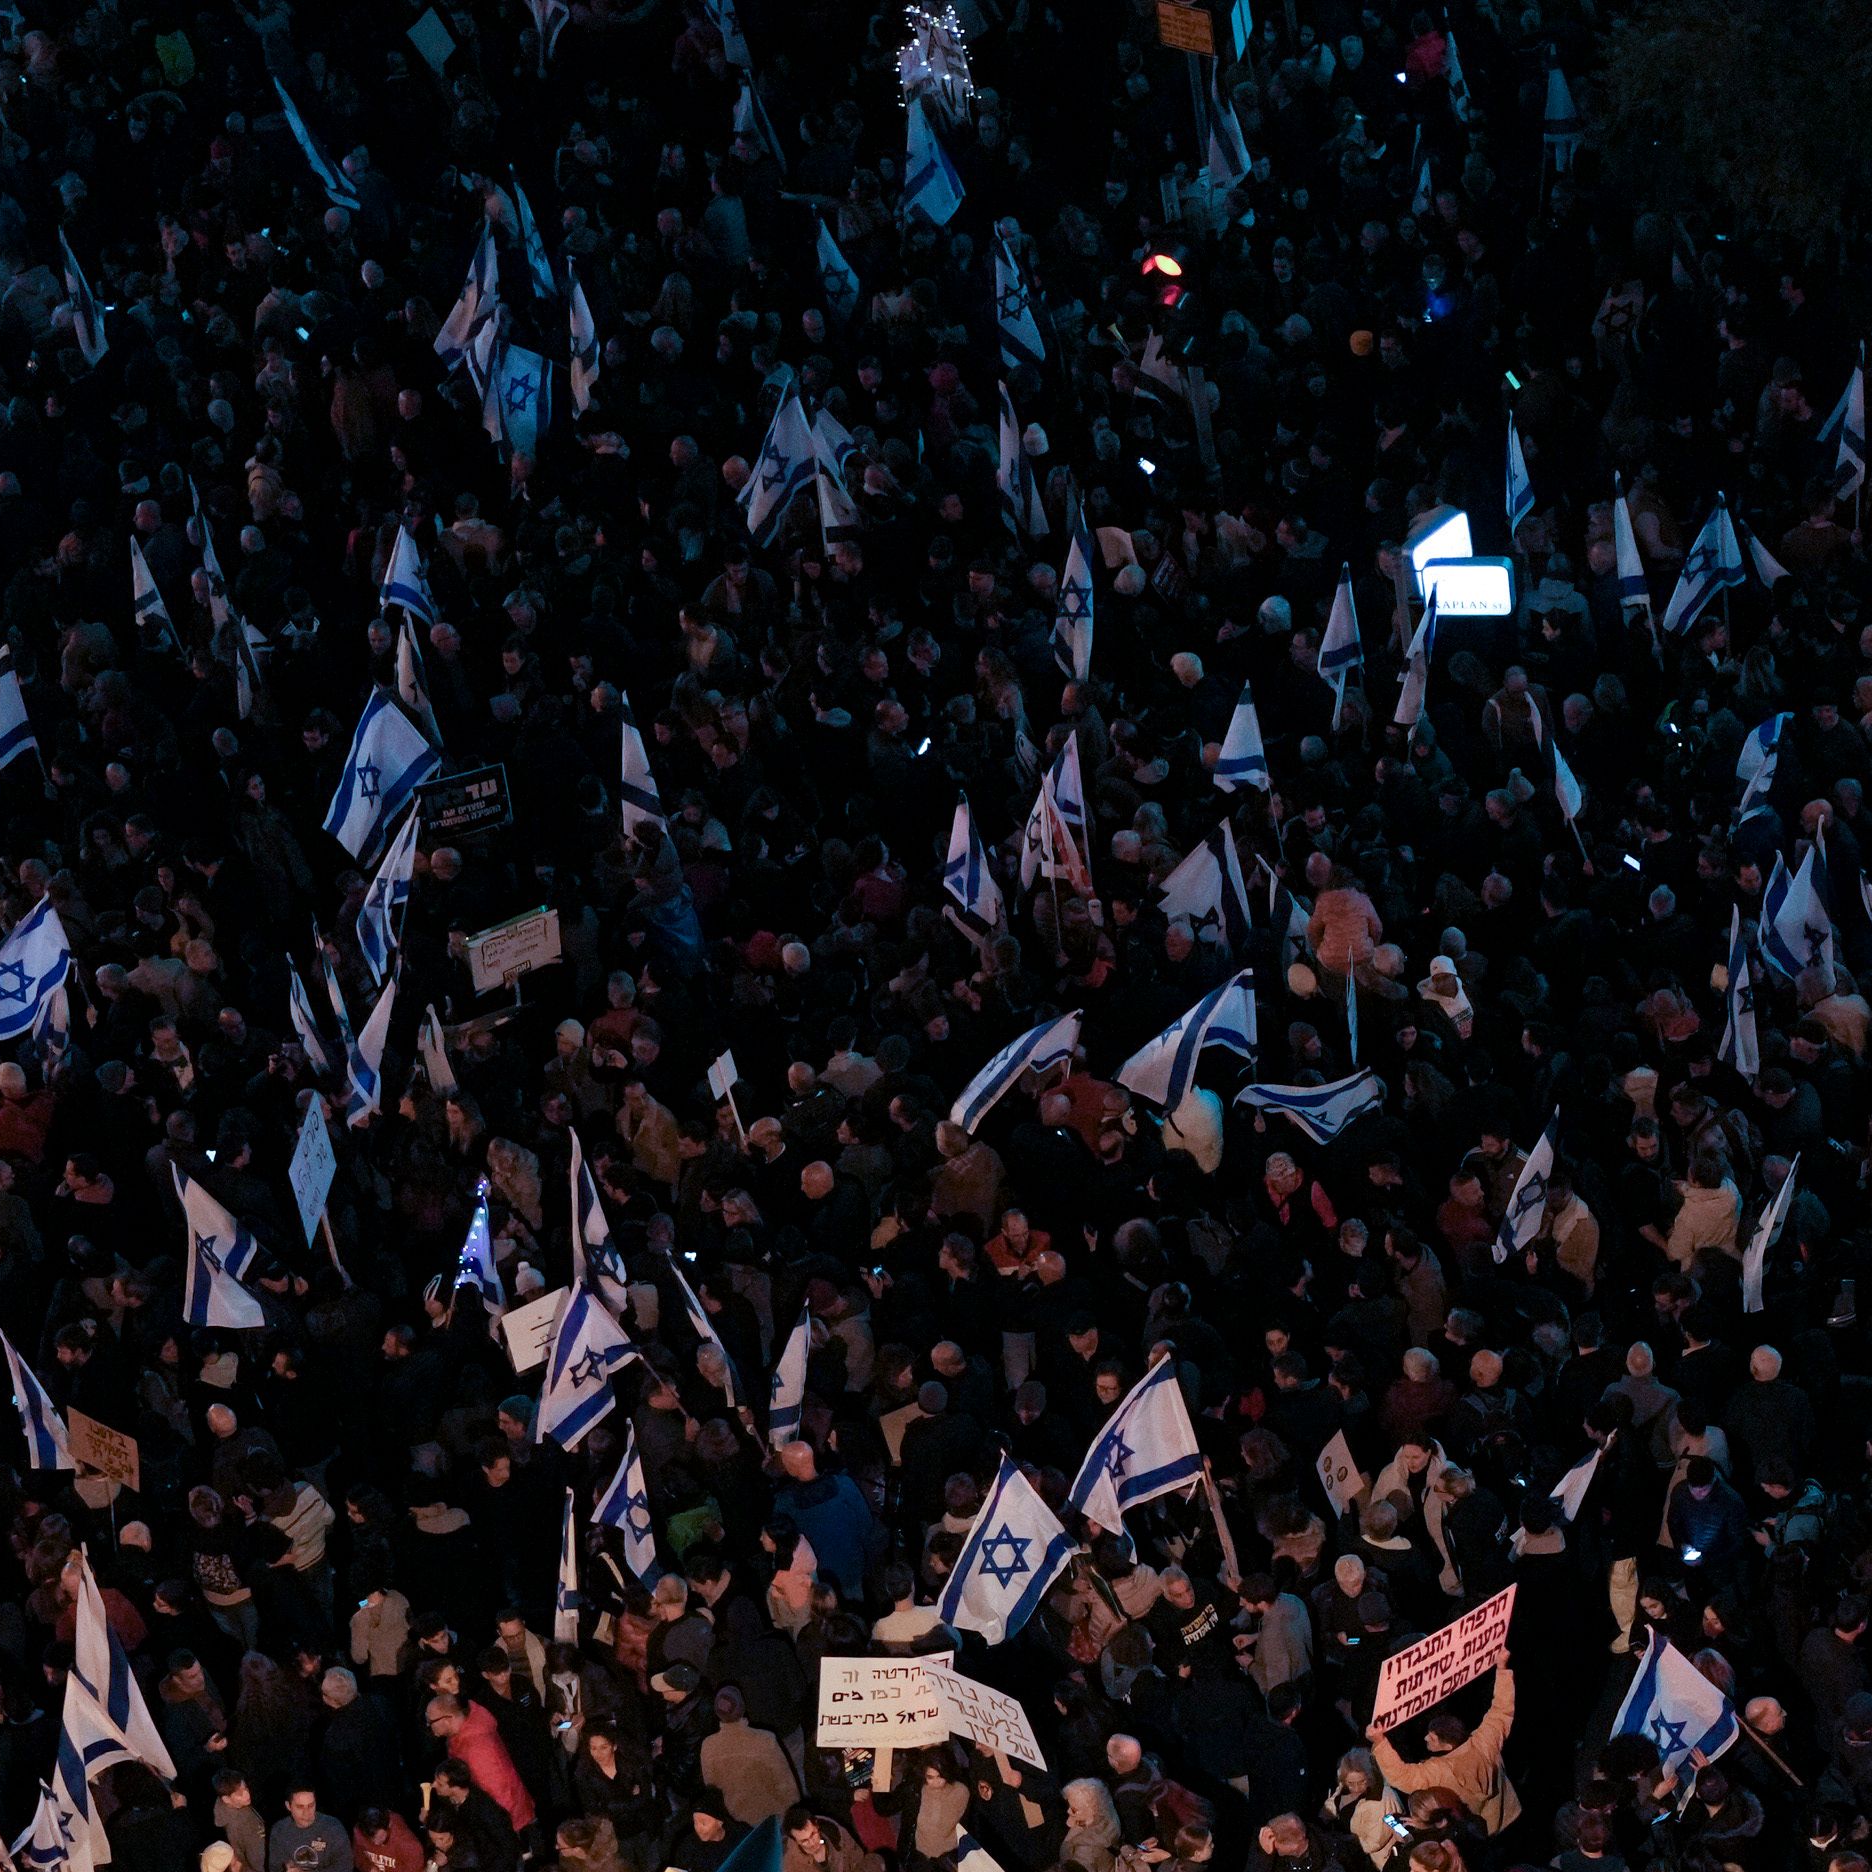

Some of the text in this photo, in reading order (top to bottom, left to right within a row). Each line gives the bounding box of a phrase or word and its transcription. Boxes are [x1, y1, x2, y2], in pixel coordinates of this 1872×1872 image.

[1386, 1592, 1508, 1680] חרפה! התנגדו!
[842, 1658, 949, 1684] דקרטיה זה
[1395, 1651, 1455, 1700] שחיתות
[1440, 1665, 1469, 1696] העם
[832, 1687, 900, 1702] כמו מים
[926, 1670, 978, 1700] נחיה
[820, 1706, 939, 1726] שראל מתייבשת
[948, 1696, 1030, 1742] במשטר
[992, 1698, 1018, 1720] לא
[966, 1720, 998, 1747] לוין
[1006, 1734, 1036, 1761] של
